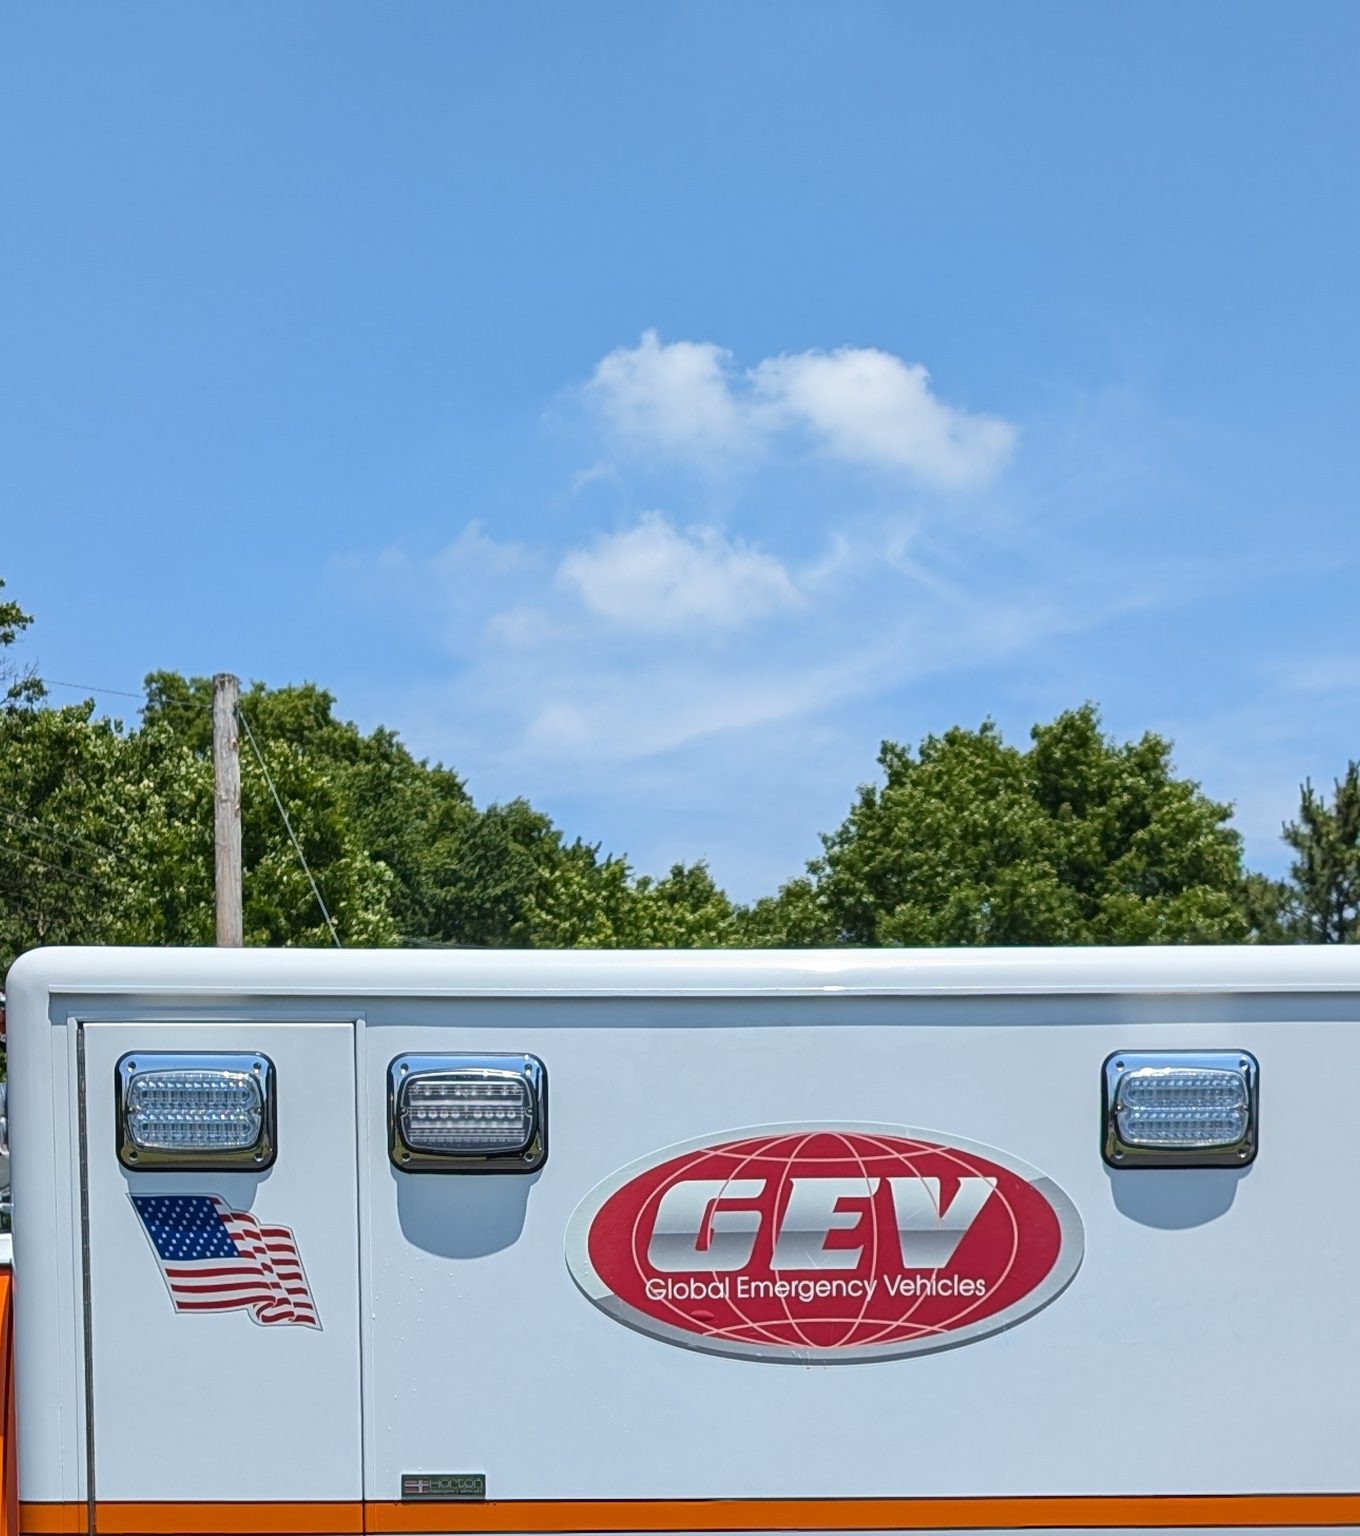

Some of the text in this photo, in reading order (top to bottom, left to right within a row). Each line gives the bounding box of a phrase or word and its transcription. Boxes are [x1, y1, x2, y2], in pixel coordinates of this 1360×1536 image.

[647, 1177, 998, 1273] GEV
[645, 1274, 986, 1302] Global Emergency Vehicles
